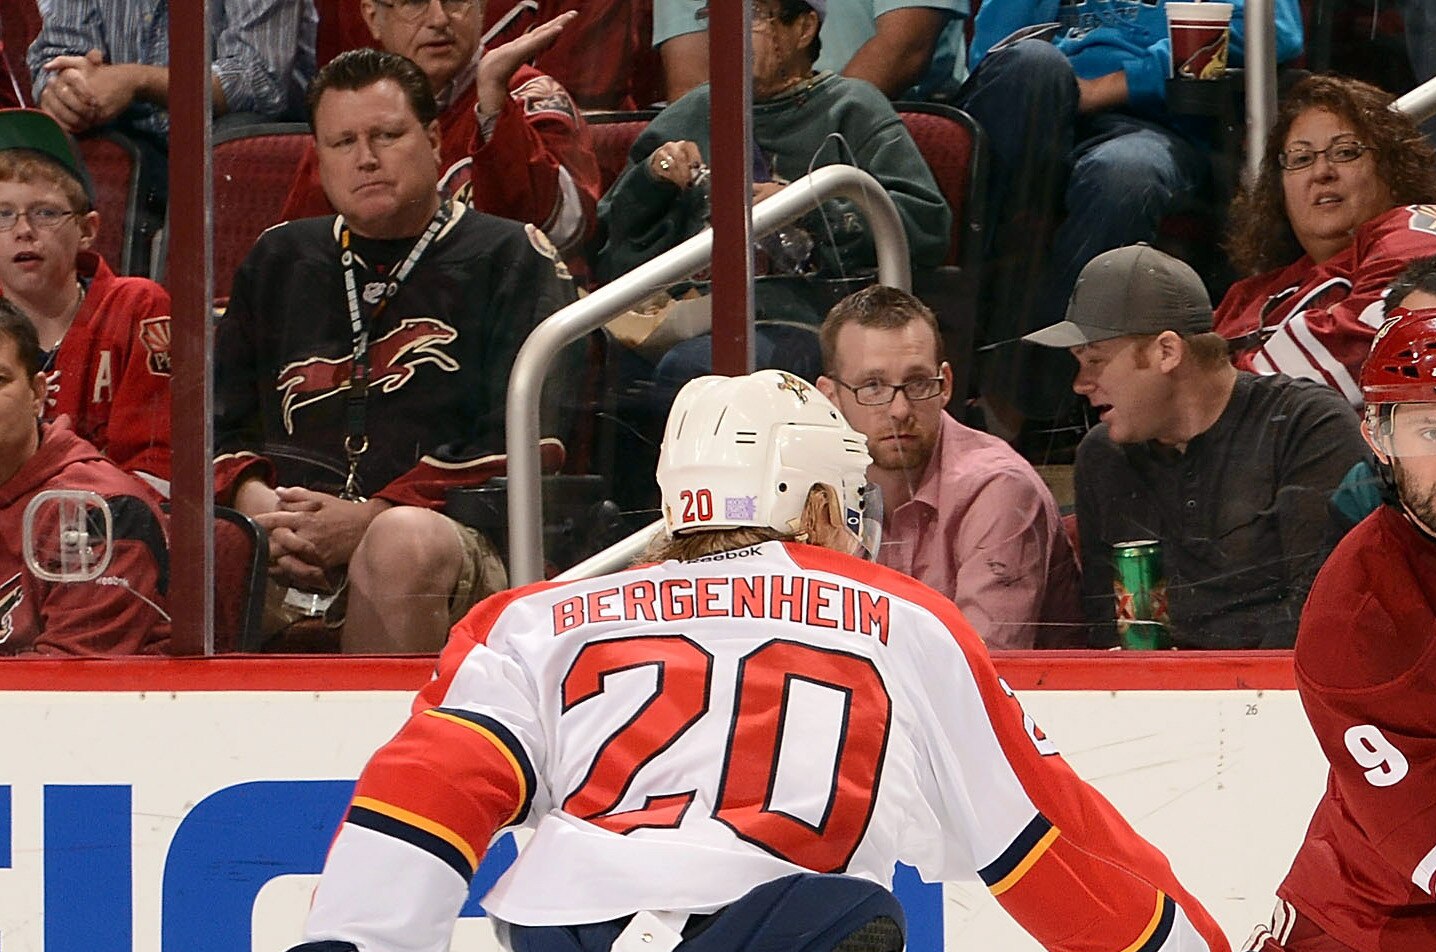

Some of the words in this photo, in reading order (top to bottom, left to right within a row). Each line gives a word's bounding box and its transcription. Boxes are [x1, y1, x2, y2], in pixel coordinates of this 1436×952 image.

[92, 350, 113, 403] A
[680, 488, 714, 523] 20
[551, 575, 890, 647] BERGENHEIM
[1245, 704, 1259, 716] 26
[561, 634, 892, 874] 20
[1343, 724, 1409, 787] 9
